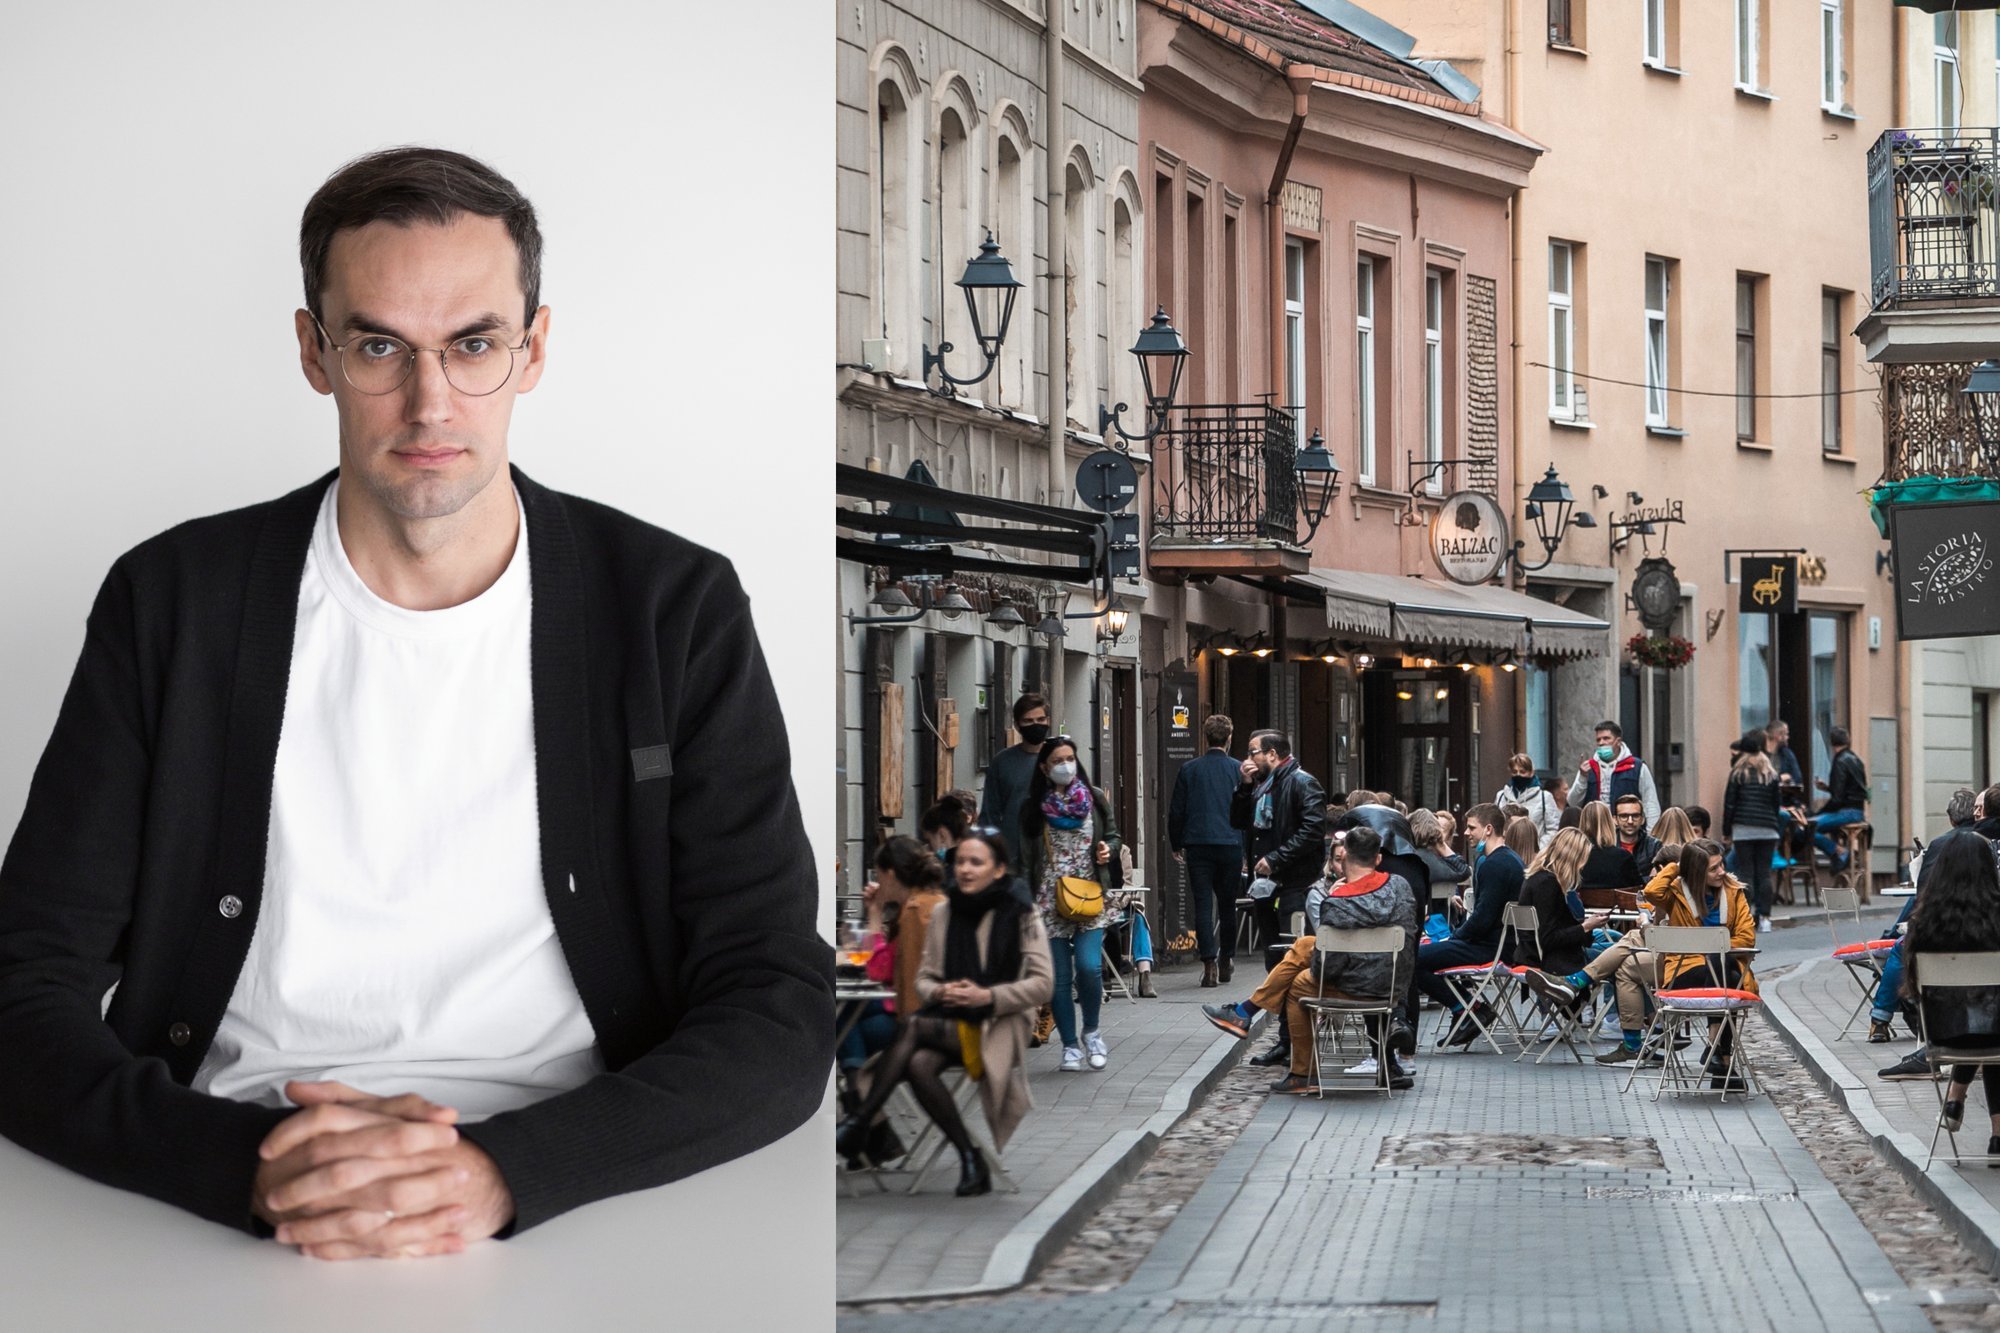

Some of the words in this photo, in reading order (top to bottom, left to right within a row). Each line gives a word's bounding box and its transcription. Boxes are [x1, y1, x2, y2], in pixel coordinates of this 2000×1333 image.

[1441, 536, 1498, 556] BALZAC
[1908, 581, 1923, 603] LA
[1918, 531, 1981, 575] STORIA
[1938, 559, 1993, 605] BISTRO
